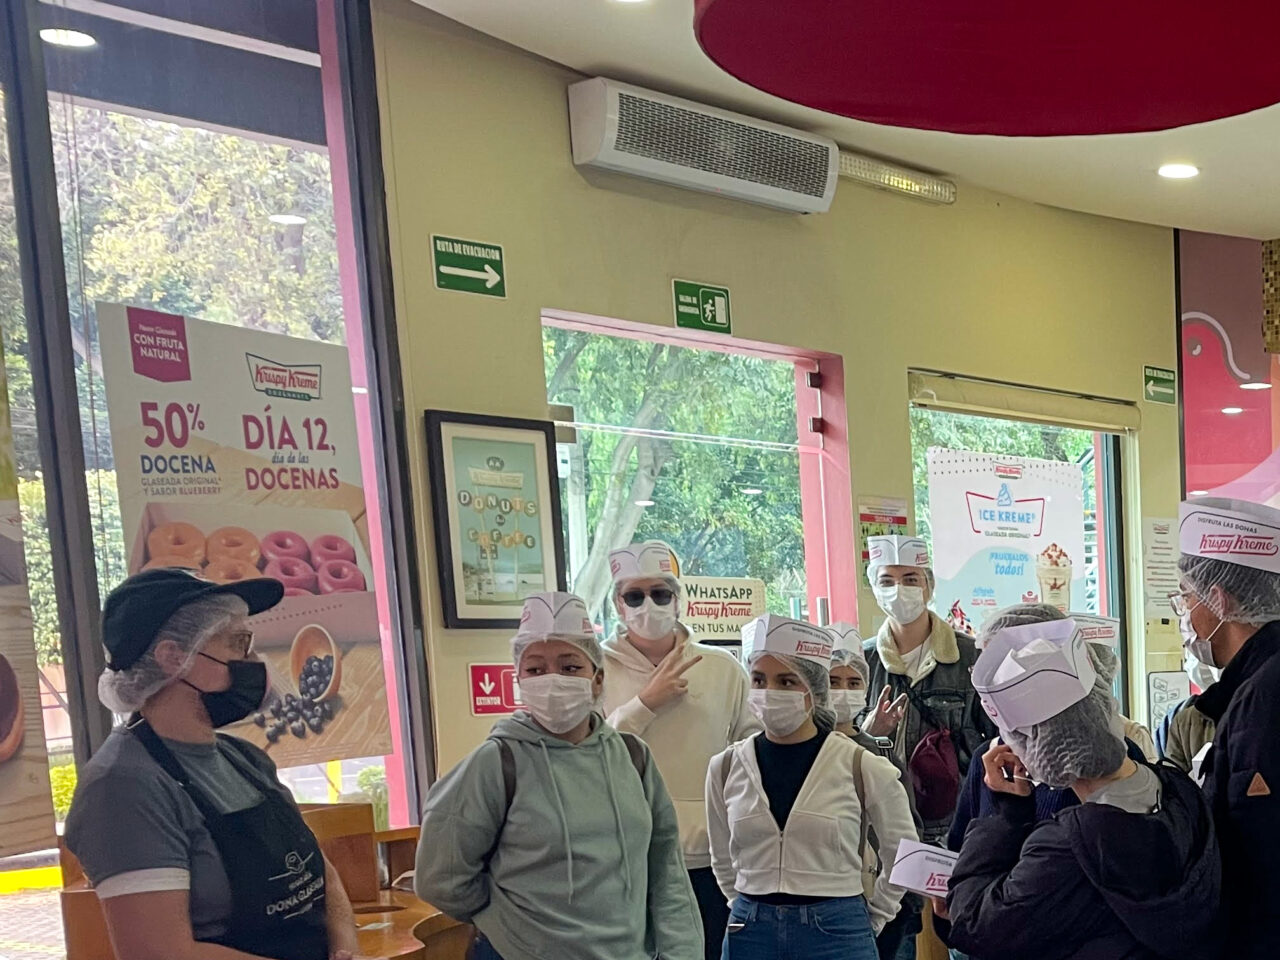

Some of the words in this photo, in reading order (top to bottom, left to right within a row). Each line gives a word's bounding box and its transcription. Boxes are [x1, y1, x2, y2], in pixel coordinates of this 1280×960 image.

[436, 240, 453, 254] RUTA
[453, 243, 462, 255] DE
[133, 333, 155, 346] CON
[156, 336, 184, 351] FRUTA
[140, 347, 182, 362] NATURAL
[255, 364, 288, 389] Krispy
[288, 370, 319, 390] Kreme
[140, 401, 205, 449] 50%
[242, 404, 299, 451] DÍA
[140, 454, 217, 474] DOCENA
[141, 476, 182, 486] GLASEADA
[245, 467, 340, 490] DOCENAS
[150, 488, 177, 497] SABOR
[179, 486, 221, 496] BLUEBERRY
[460, 491, 536, 514] DONUTS
[979, 508, 996, 522] ICE
[1197, 517, 1222, 526] DISFRUTA
[1223, 521, 1234, 529] LAS
[1235, 524, 1258, 534] DONAS
[1199, 534, 1234, 553] Krispy
[1234, 534, 1278, 554] Kreme
[687, 601, 720, 619] Krispy
[721, 602, 753, 618] Kreme
[693, 623, 705, 633] EN
[707, 623, 726, 633] TUS
